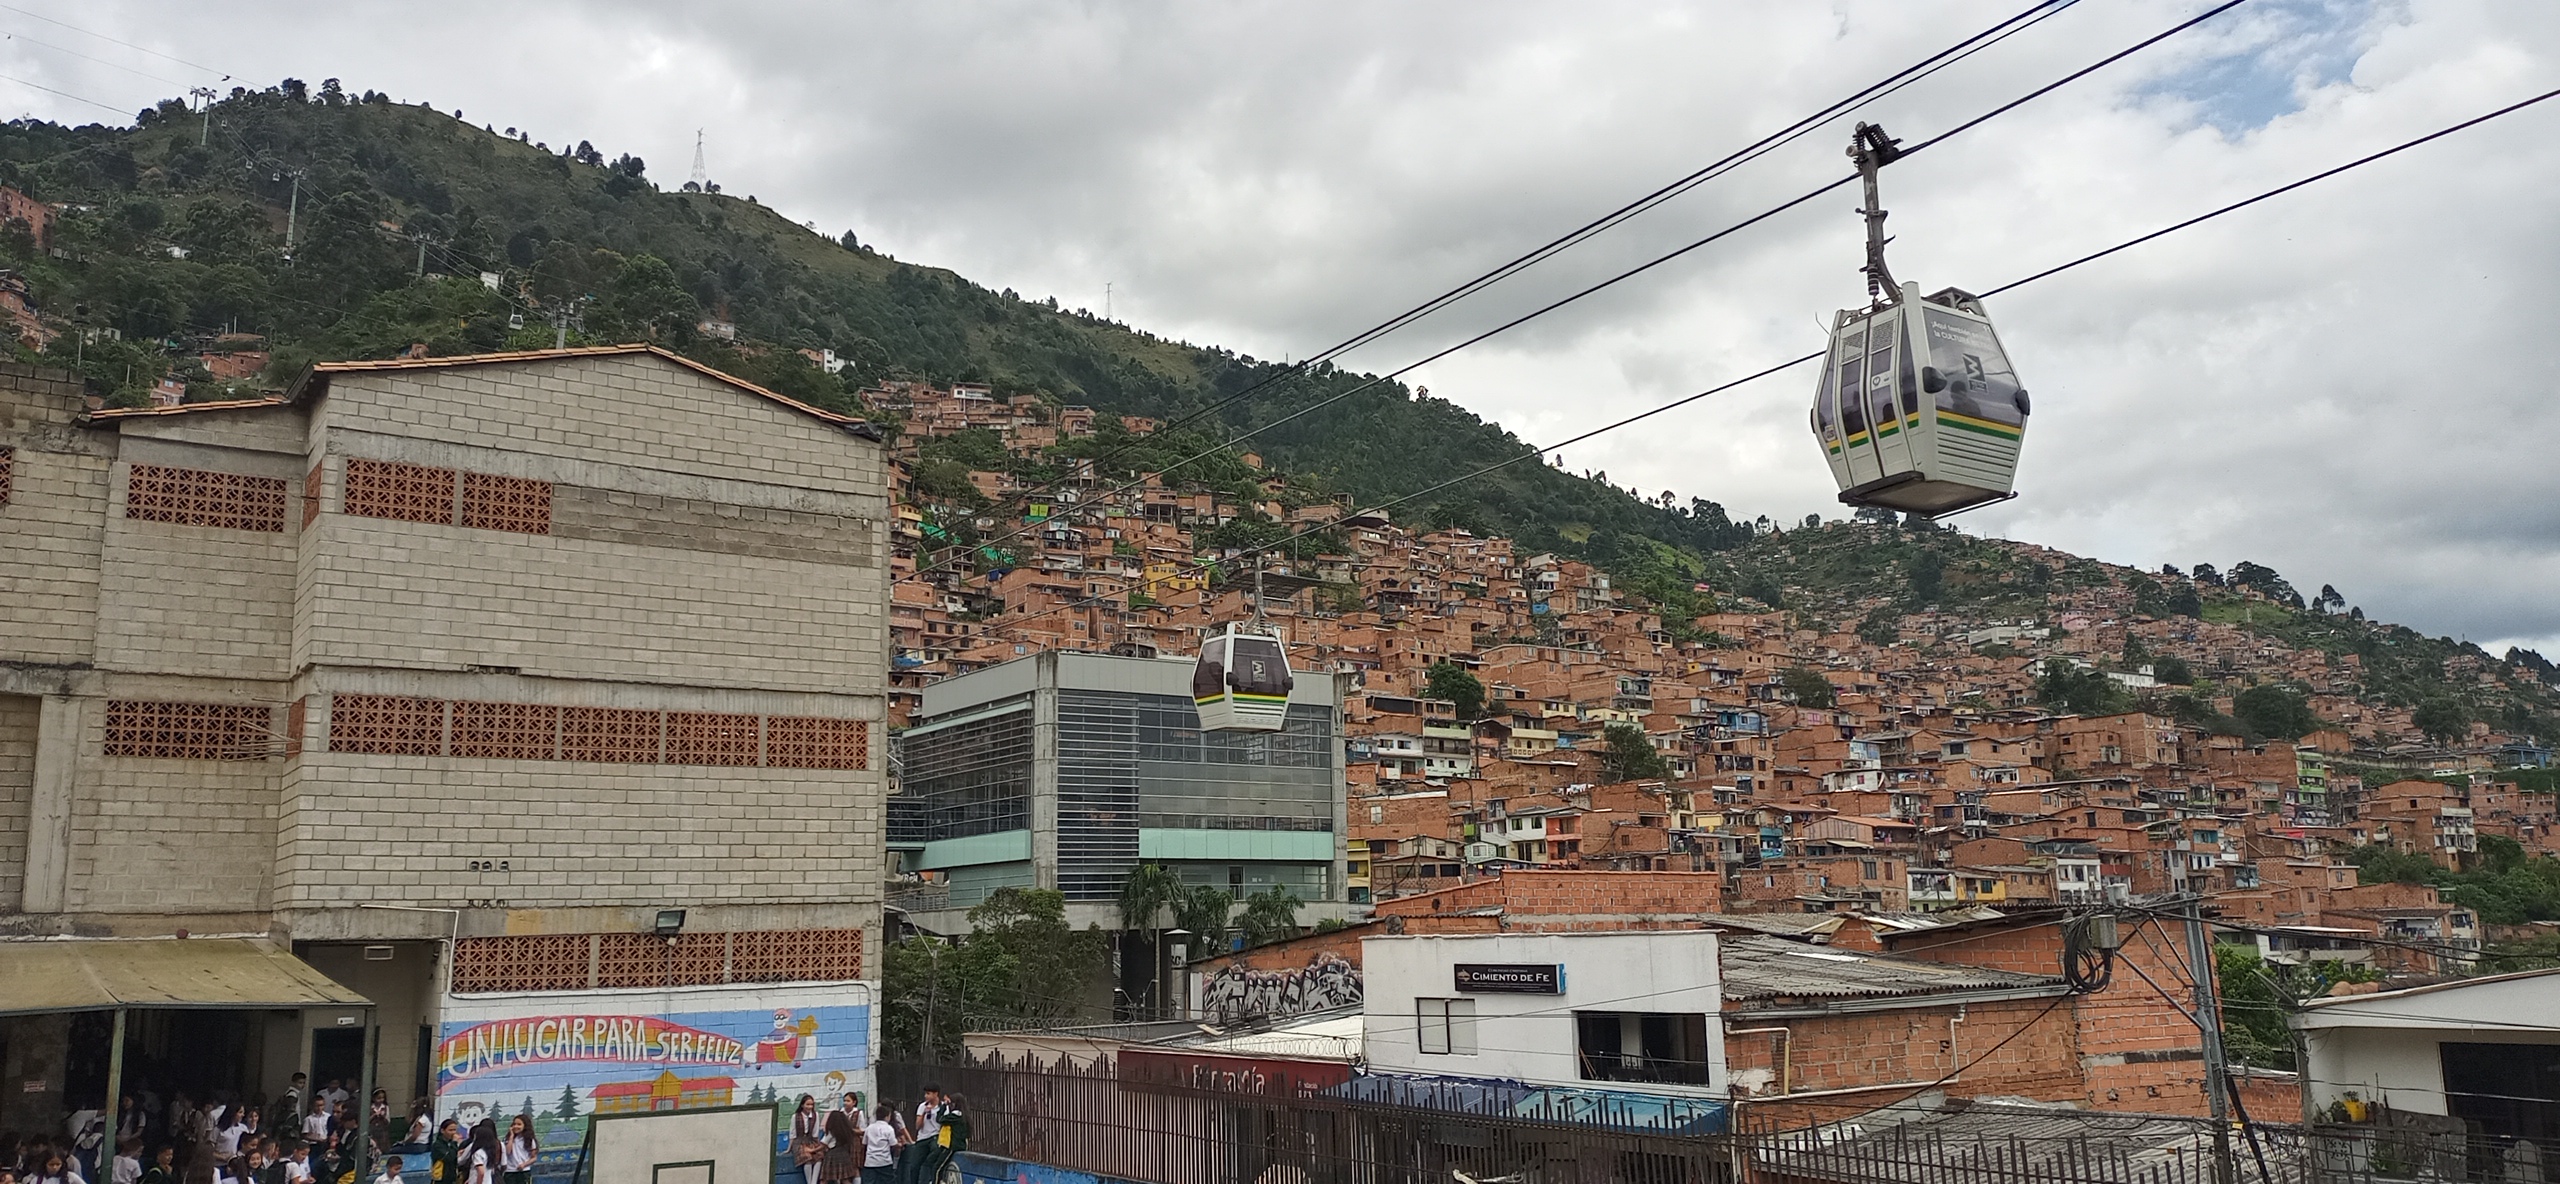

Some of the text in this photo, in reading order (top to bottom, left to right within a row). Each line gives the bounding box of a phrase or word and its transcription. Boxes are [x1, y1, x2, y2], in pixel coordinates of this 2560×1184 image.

[1472, 972, 1550, 982] CIMIENTO DE FE
[448, 1018, 742, 1078] UN LUGAR PARA SER FELIZ
